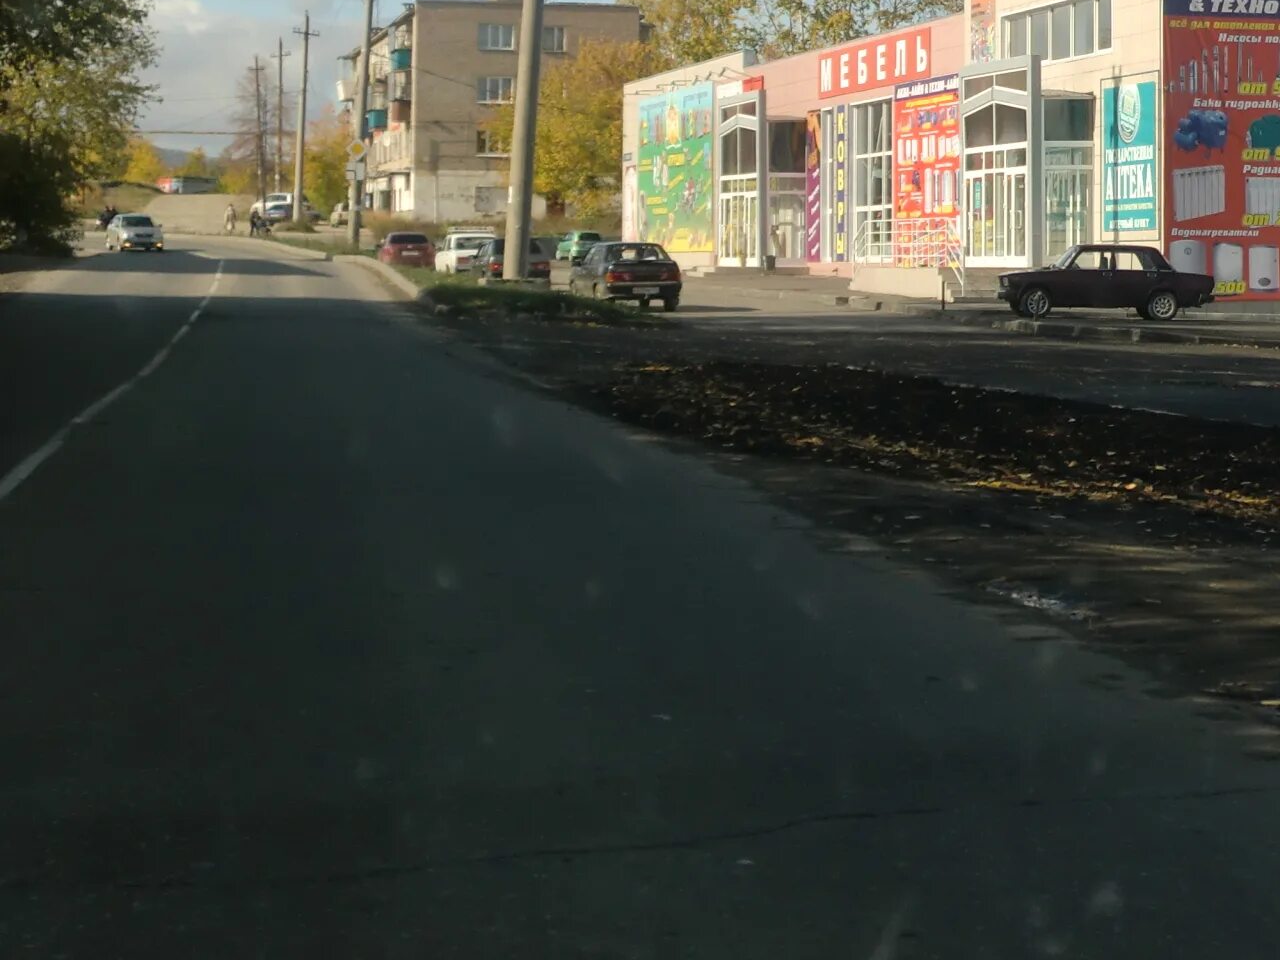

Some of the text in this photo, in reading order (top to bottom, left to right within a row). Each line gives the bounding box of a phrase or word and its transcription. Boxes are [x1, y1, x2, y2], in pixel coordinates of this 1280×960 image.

[1218, 32, 1262, 43] Насосы
[820, 35, 928, 93] МЕБЕЛЬ
[1238, 82, 1267, 95] от
[1193, 98, 1222, 108] Баки
[1242, 148, 1270, 160] от
[836, 112, 845, 254] КОВРЫ
[1105, 162, 1153, 201] АПТЕКА
[1243, 213, 1270, 226] от
[1171, 227, 1260, 238] Водонагреватели
